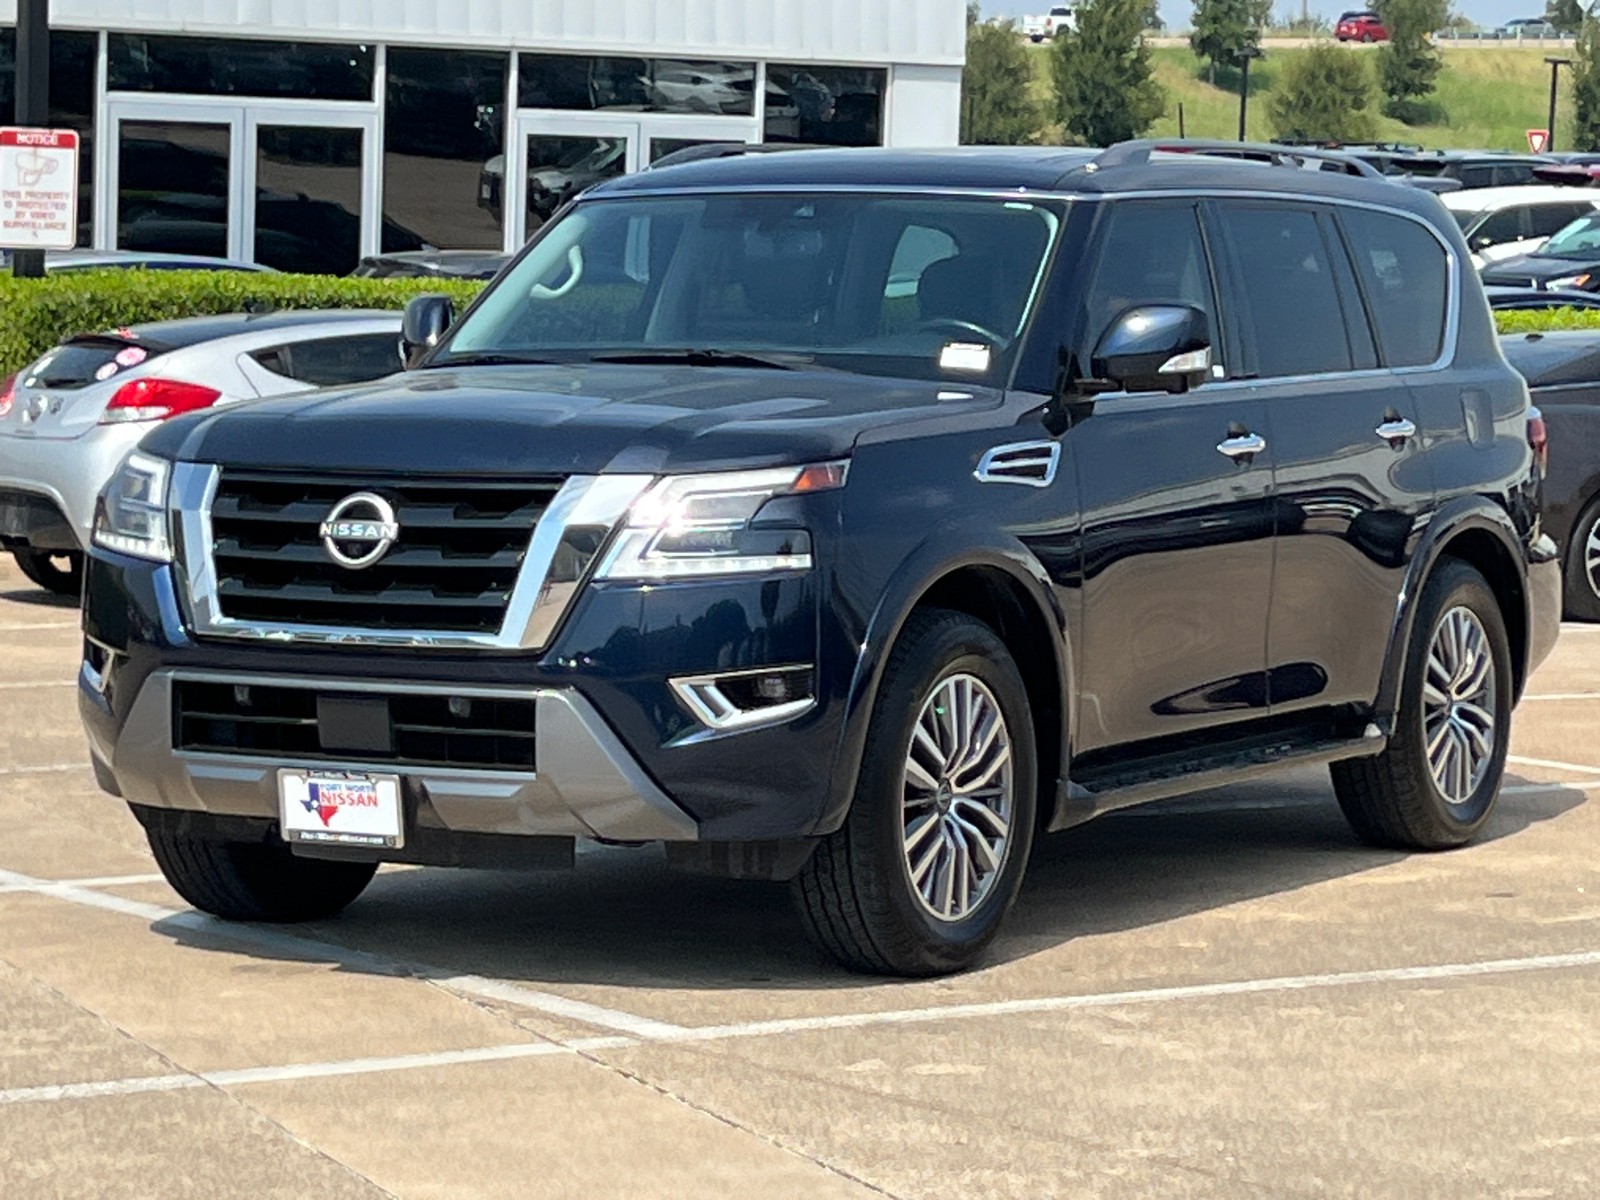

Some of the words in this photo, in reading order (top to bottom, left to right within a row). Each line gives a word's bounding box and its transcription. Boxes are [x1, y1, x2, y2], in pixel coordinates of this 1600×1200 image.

[16, 133, 58, 144] NOTICE
[320, 522, 398, 539] NISSAN
[320, 783, 342, 792] FORT
[345, 784, 377, 793] WORT
[321, 791, 378, 807] NISSAN
